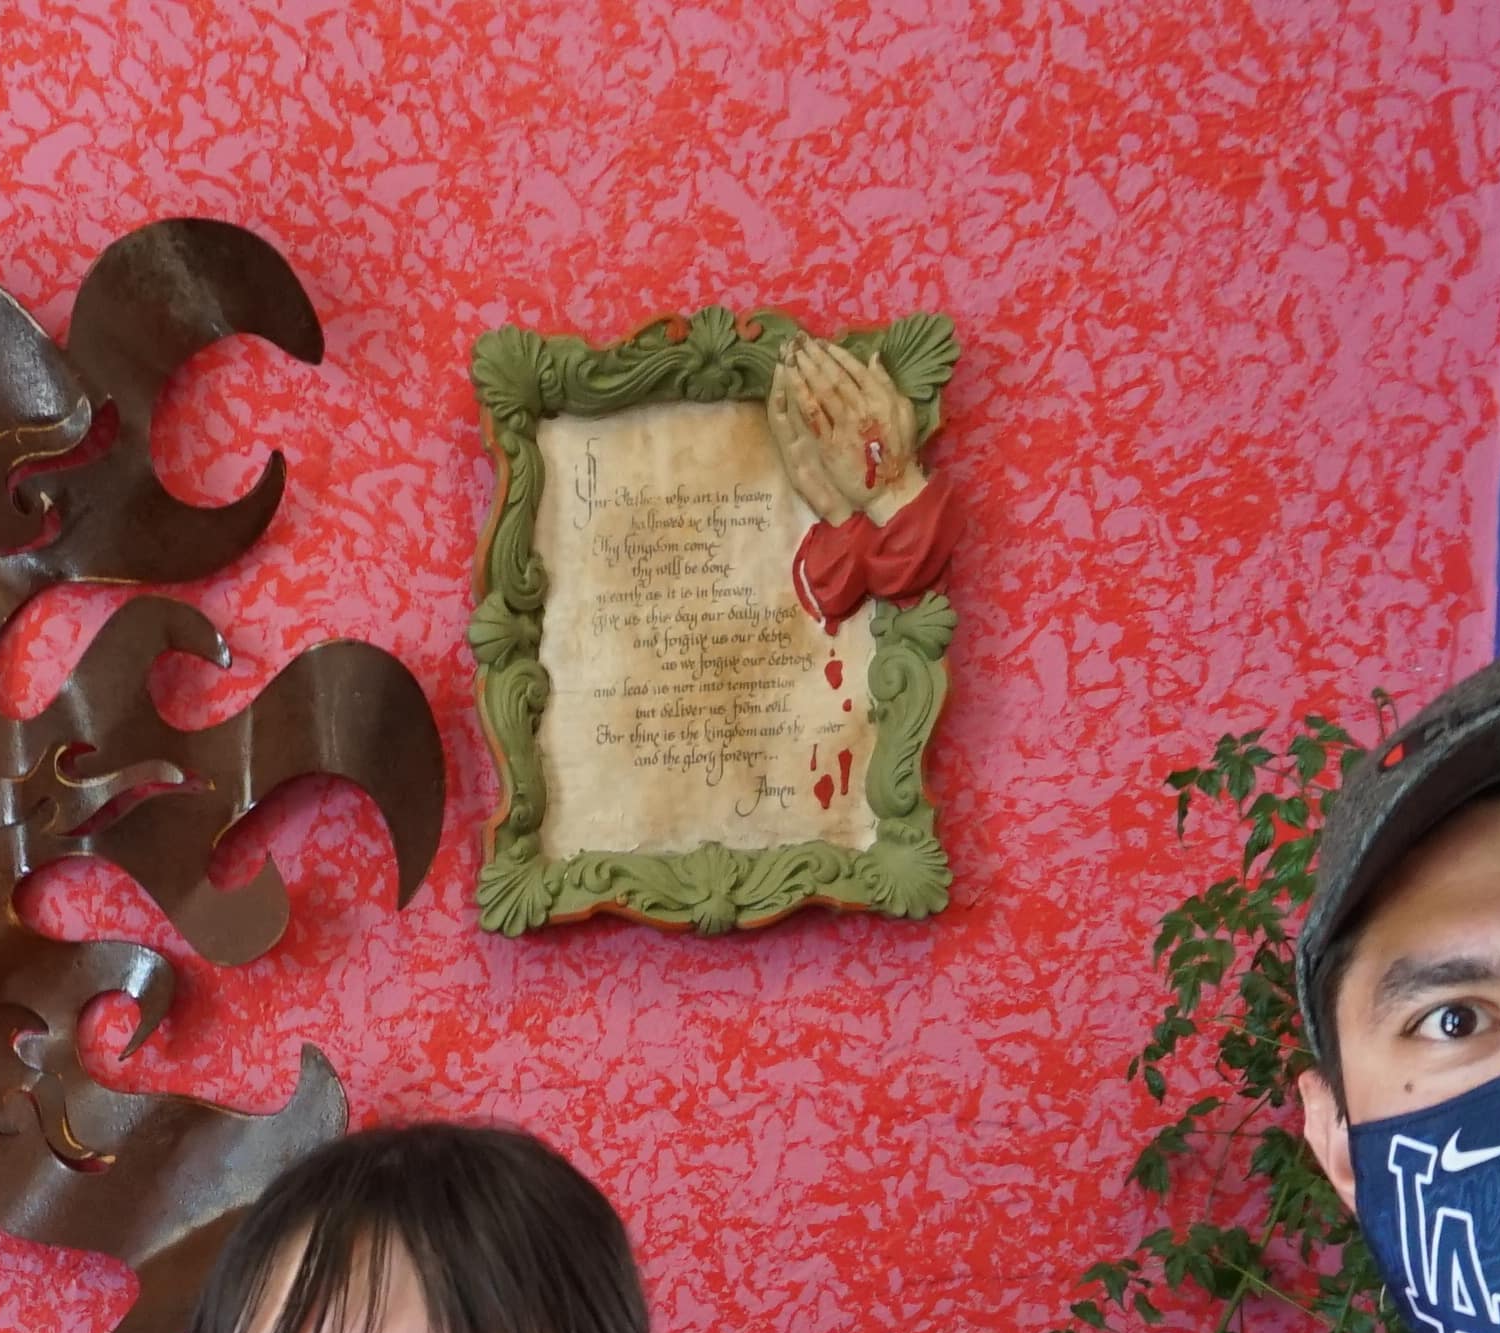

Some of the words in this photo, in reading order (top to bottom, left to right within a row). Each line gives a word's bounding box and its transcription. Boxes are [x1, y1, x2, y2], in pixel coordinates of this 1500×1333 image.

[614, 484, 661, 507] Fath
[664, 484, 691, 509] who
[693, 492, 712, 503] art
[715, 490, 729, 503] in
[733, 483, 773, 510] heaven
[707, 505, 727, 538] thy
[592, 534, 621, 568] Thy
[623, 531, 680, 561] kingdom
[684, 541, 721, 558] come
[632, 557, 653, 588] thy
[656, 556, 684, 579] will
[684, 563, 698, 575] be
[701, 558, 736, 578] done
[609, 584, 643, 607] earth
[645, 591, 663, 601] as
[667, 586, 677, 599] it
[680, 586, 693, 599] is
[696, 586, 708, 599] in
[624, 614, 641, 626] us
[646, 603, 672, 631] this
[675, 605, 698, 631] day
[701, 611, 724, 621] our
[728, 604, 760, 628] daily
[764, 603, 798, 624] bread
[633, 632, 658, 649] and
[656, 626, 710, 658] forgive
[711, 633, 728, 645] us
[731, 633, 755, 643] our
[757, 626, 793, 649] debts
[661, 660, 678, 671] as
[680, 658, 696, 671] we
[741, 656, 766, 666] our
[594, 685, 618, 699] and
[623, 675, 653, 697] lead
[653, 684, 670, 696] us
[673, 682, 696, 693] not
[698, 680, 725, 693] into
[727, 677, 796, 699] temptation
[635, 706, 656, 720] but
[660, 697, 708, 719] deliver
[709, 703, 727, 716] us
[595, 723, 624, 745] For
[629, 721, 660, 749] thine
[663, 729, 677, 741] is
[681, 719, 699, 746] the
[704, 718, 757, 749] kingdom
[759, 720, 788, 737] and
[634, 749, 661, 768] and
[663, 744, 681, 772] the
[683, 744, 716, 775] glory
[735, 773, 797, 818] Amen
